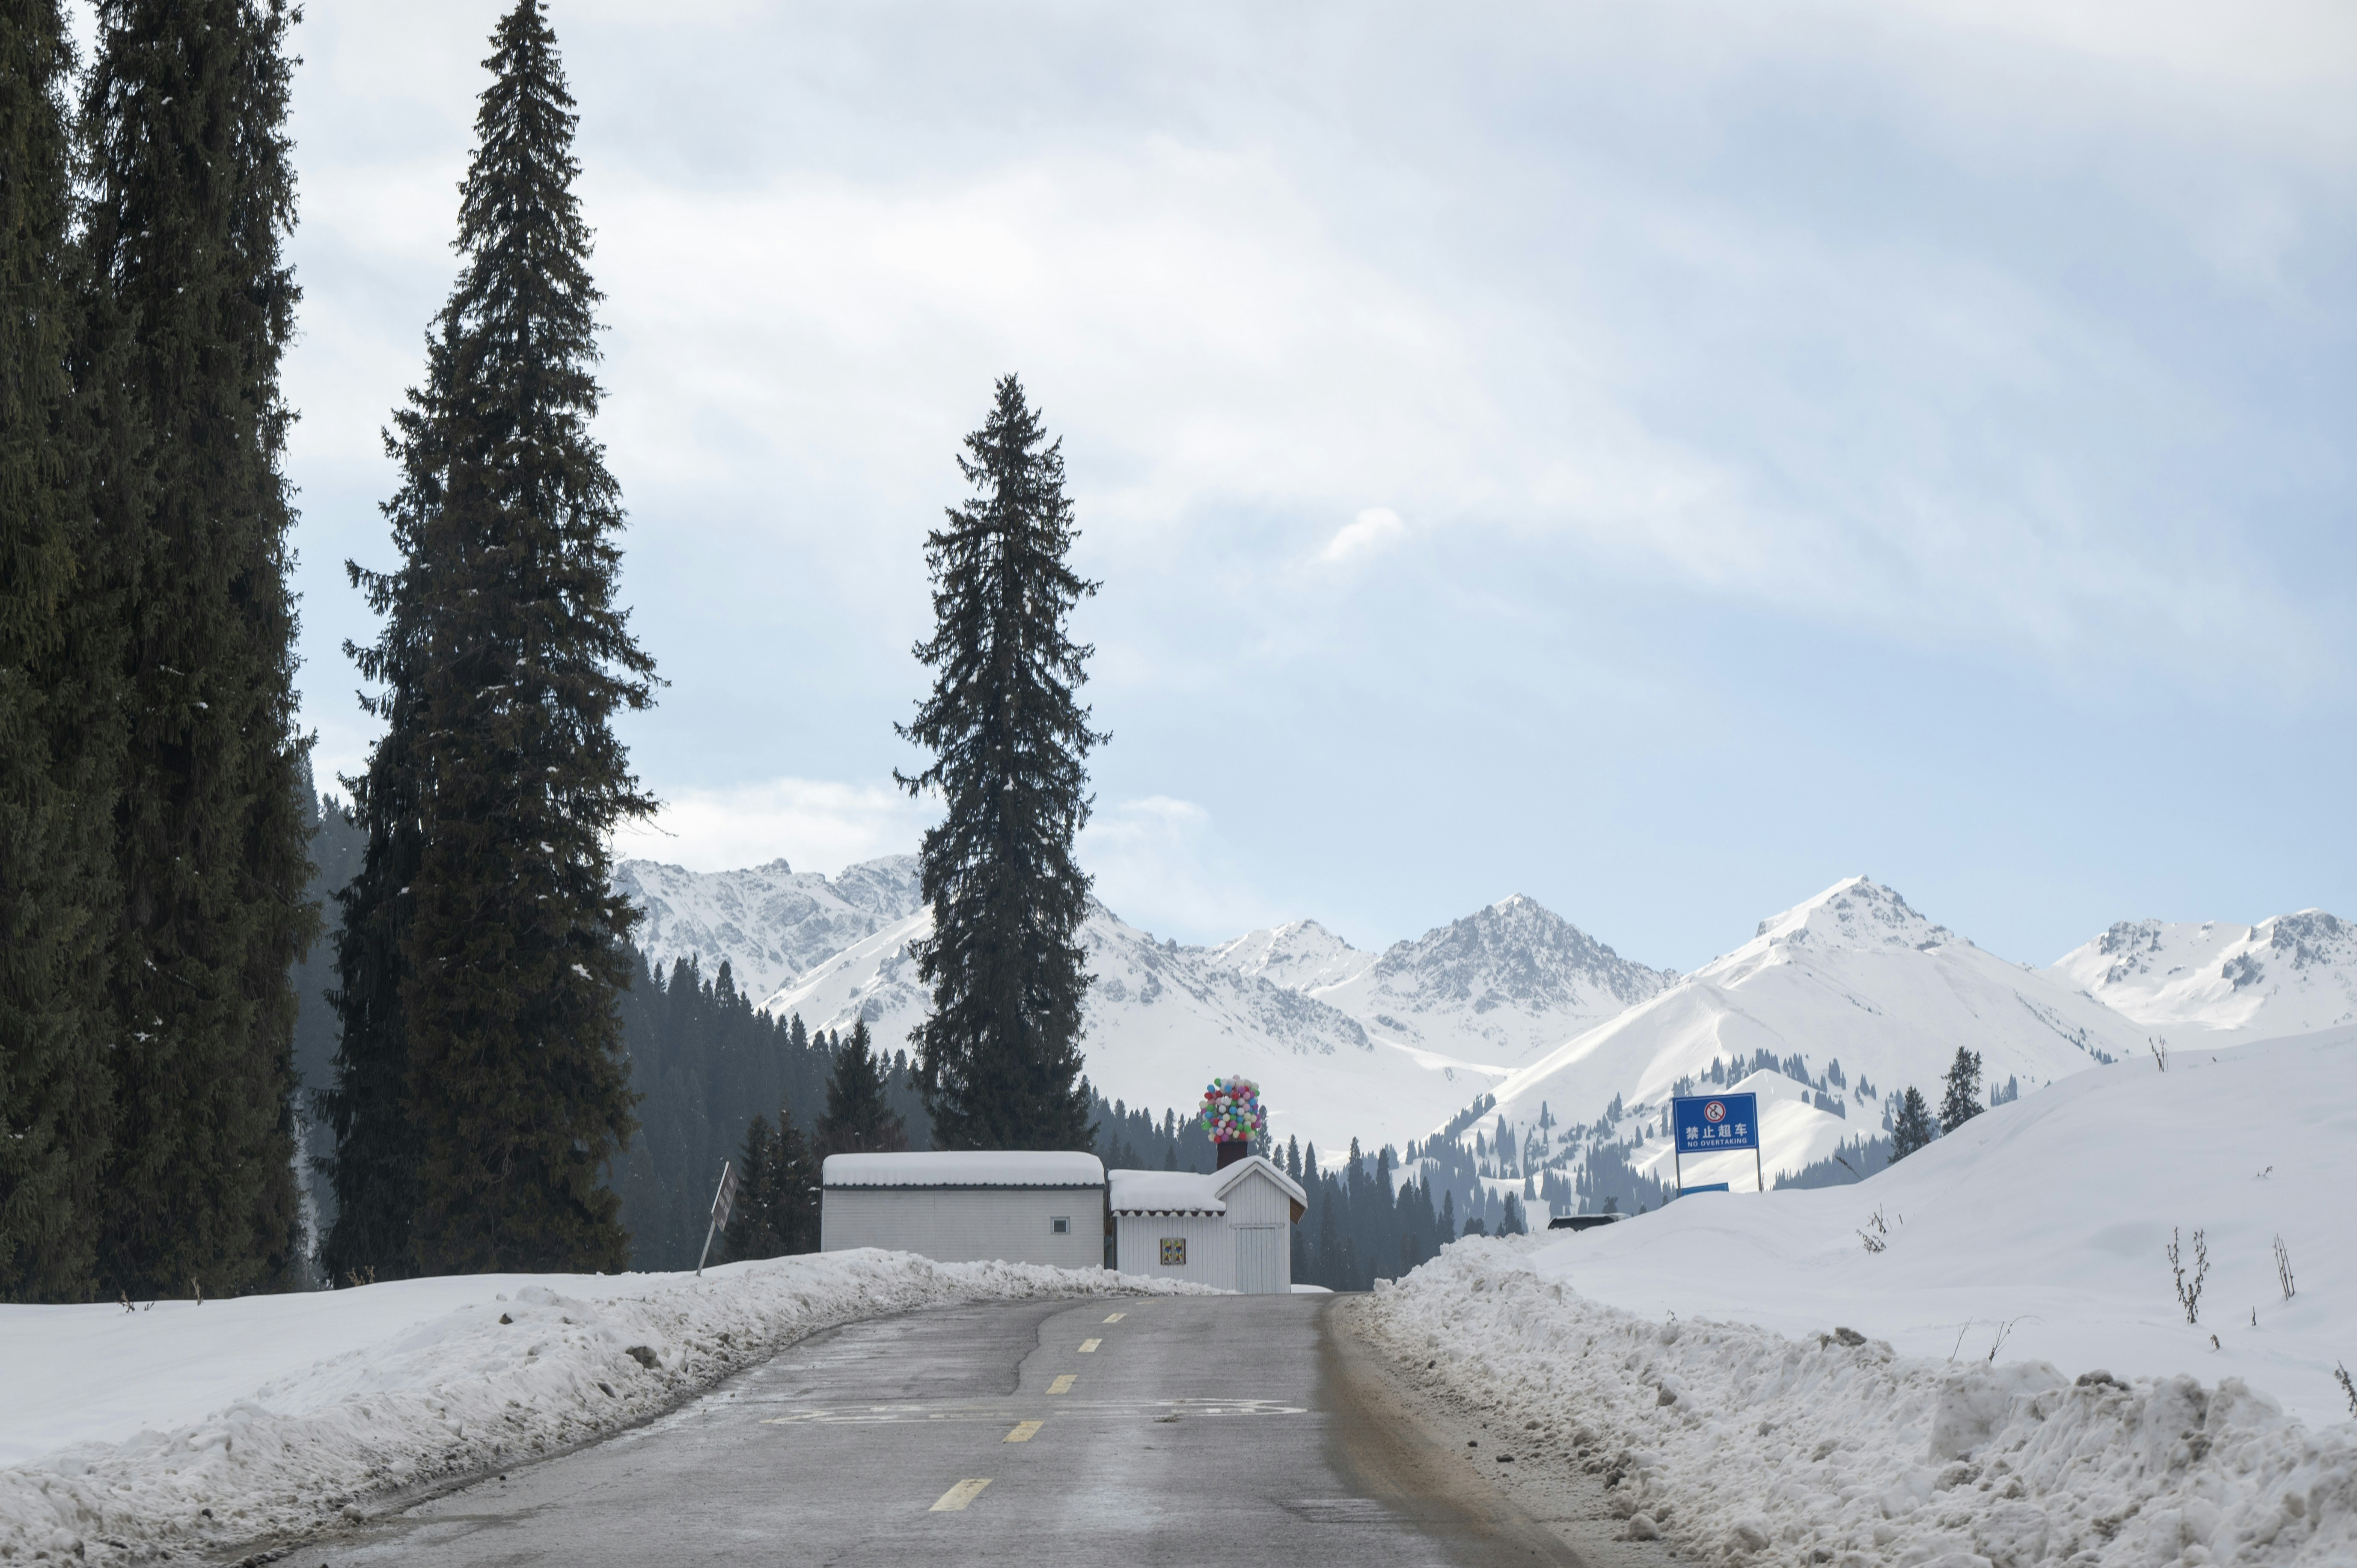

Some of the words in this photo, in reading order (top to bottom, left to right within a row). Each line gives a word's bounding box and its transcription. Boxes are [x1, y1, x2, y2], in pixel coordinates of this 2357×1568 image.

[1686, 1123, 1747, 1140] 禁止超车
[1701, 1137, 1747, 1146] OVERTAKING
